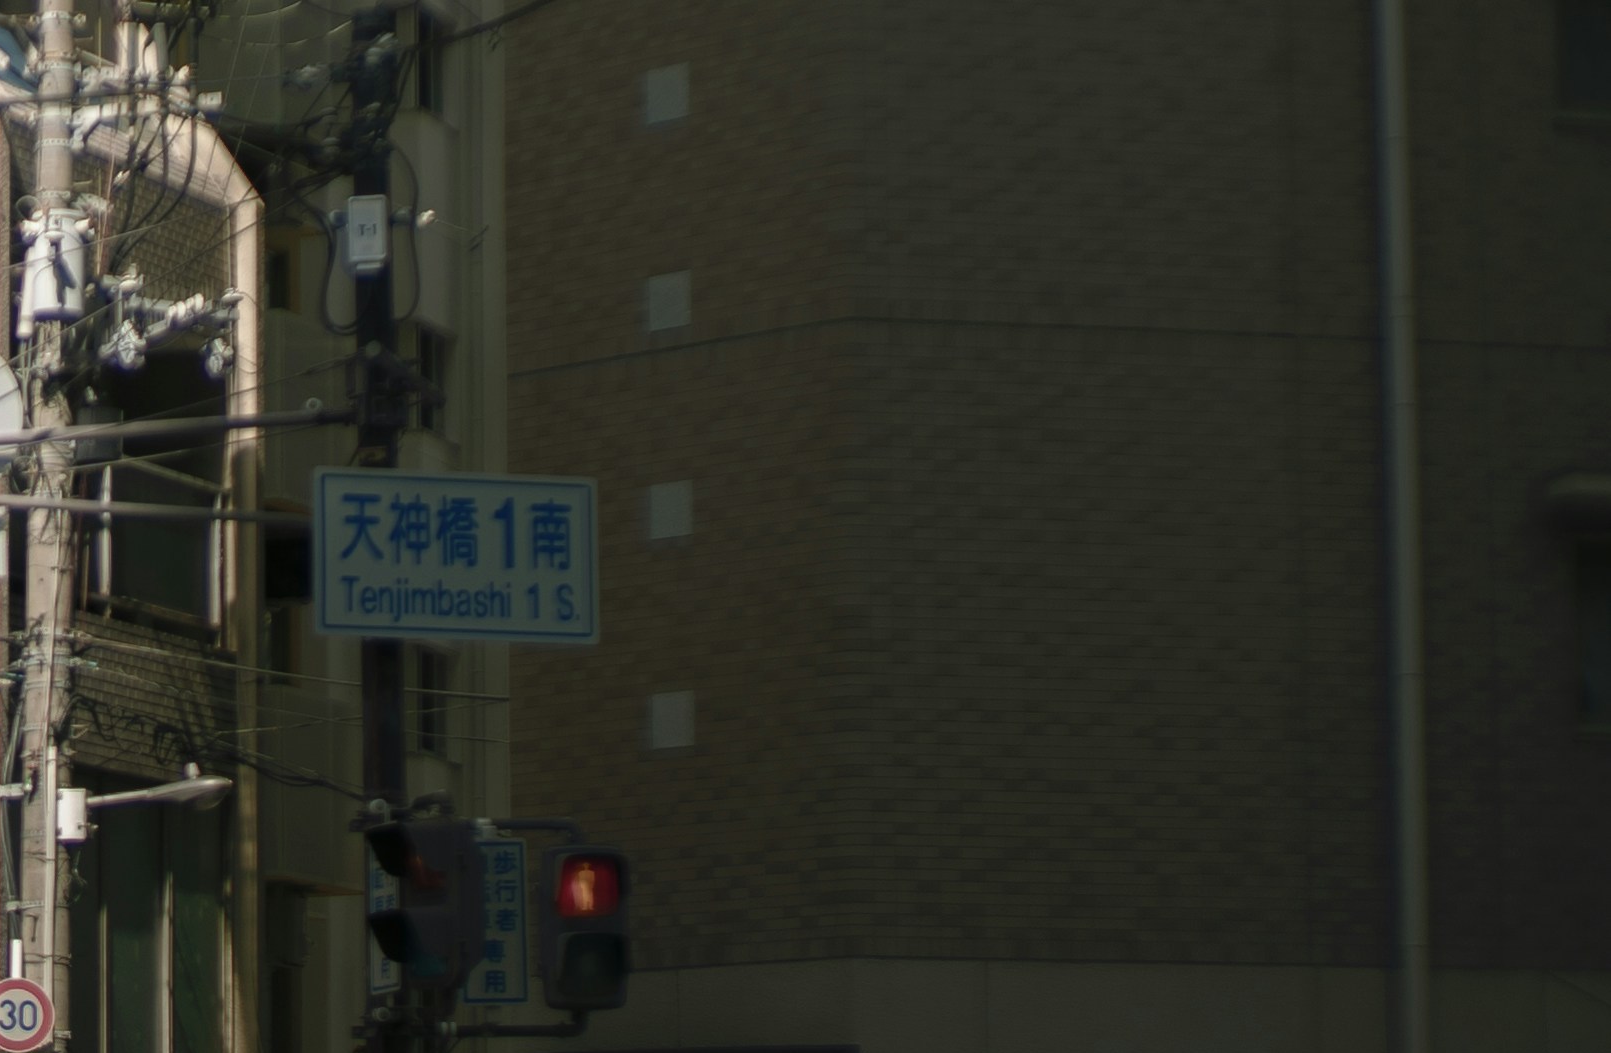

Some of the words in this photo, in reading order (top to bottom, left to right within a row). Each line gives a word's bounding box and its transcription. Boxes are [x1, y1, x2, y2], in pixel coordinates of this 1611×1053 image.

[340, 491, 573, 571] 天神橋1南
[341, 575, 511, 623] Tenjimbashi
[526, 582, 541, 619] 1
[556, 584, 581, 622] S.
[494, 850, 519, 932] 歩行者
